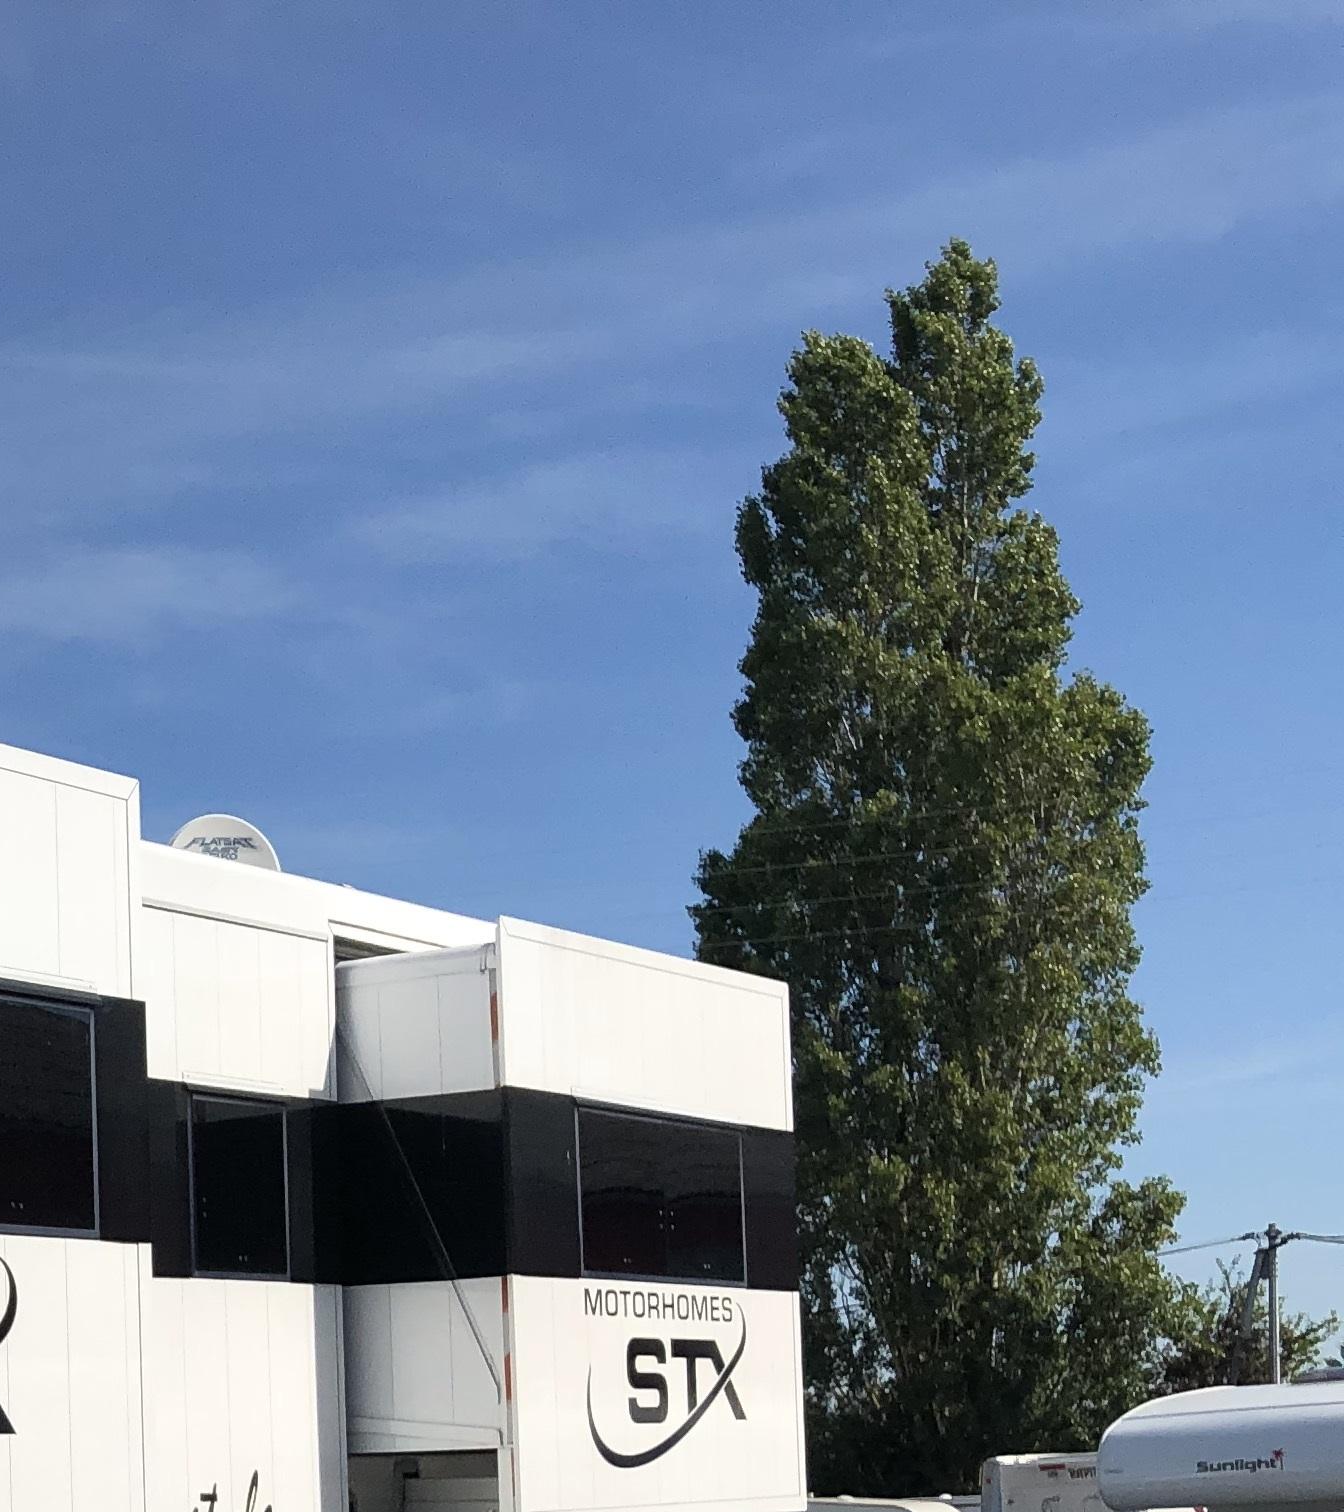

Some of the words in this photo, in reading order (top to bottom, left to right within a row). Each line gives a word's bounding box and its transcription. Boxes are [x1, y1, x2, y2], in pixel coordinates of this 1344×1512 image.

[583, 1287, 733, 1323] MOTORHOMES
[626, 1336, 748, 1424] STX
[1195, 1458, 1277, 1474] Sunlight
